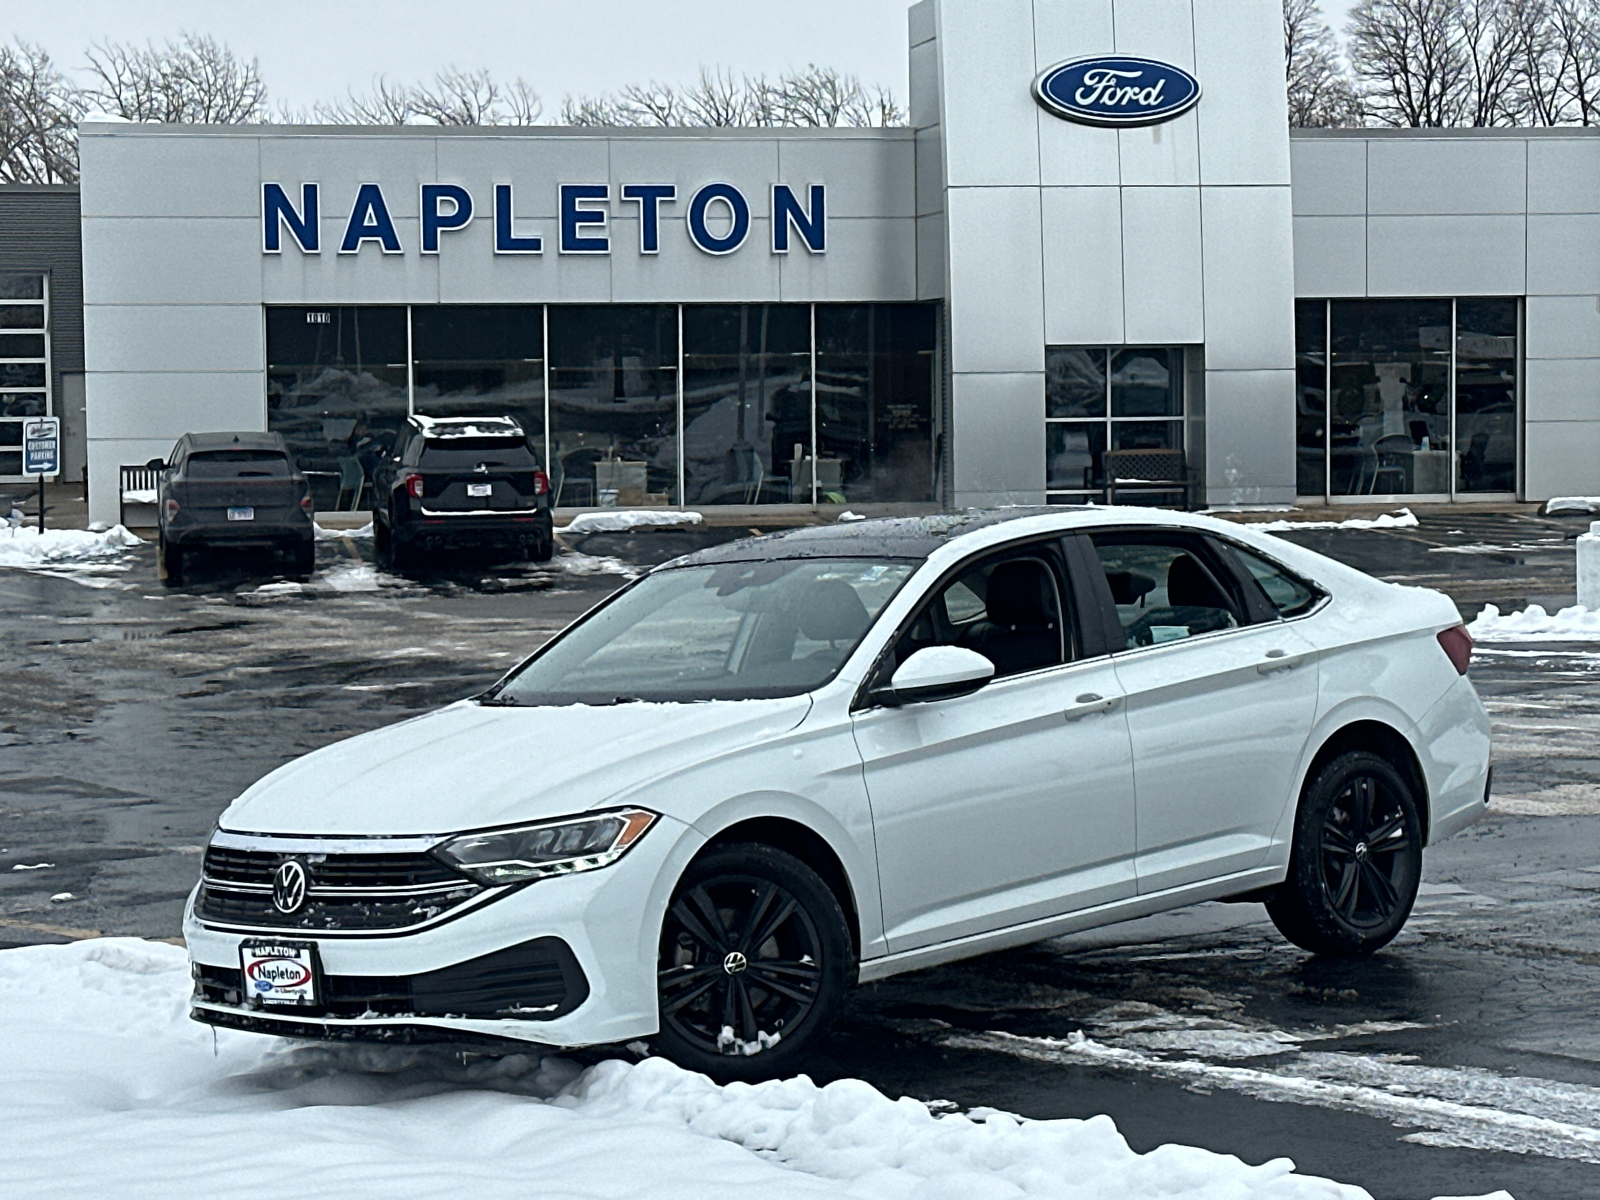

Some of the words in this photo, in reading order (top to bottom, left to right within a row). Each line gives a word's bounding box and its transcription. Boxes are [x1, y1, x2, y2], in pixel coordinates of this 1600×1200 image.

[1075, 68, 1166, 106] Ford
[261, 182, 826, 255] NAPLETON
[306, 312, 331, 324] 1010
[28, 440, 56, 451] CUSTOMER
[30, 450, 55, 461] PARKING
[254, 946, 297, 957] NAPLETON
[258, 965, 301, 982] Napleton
